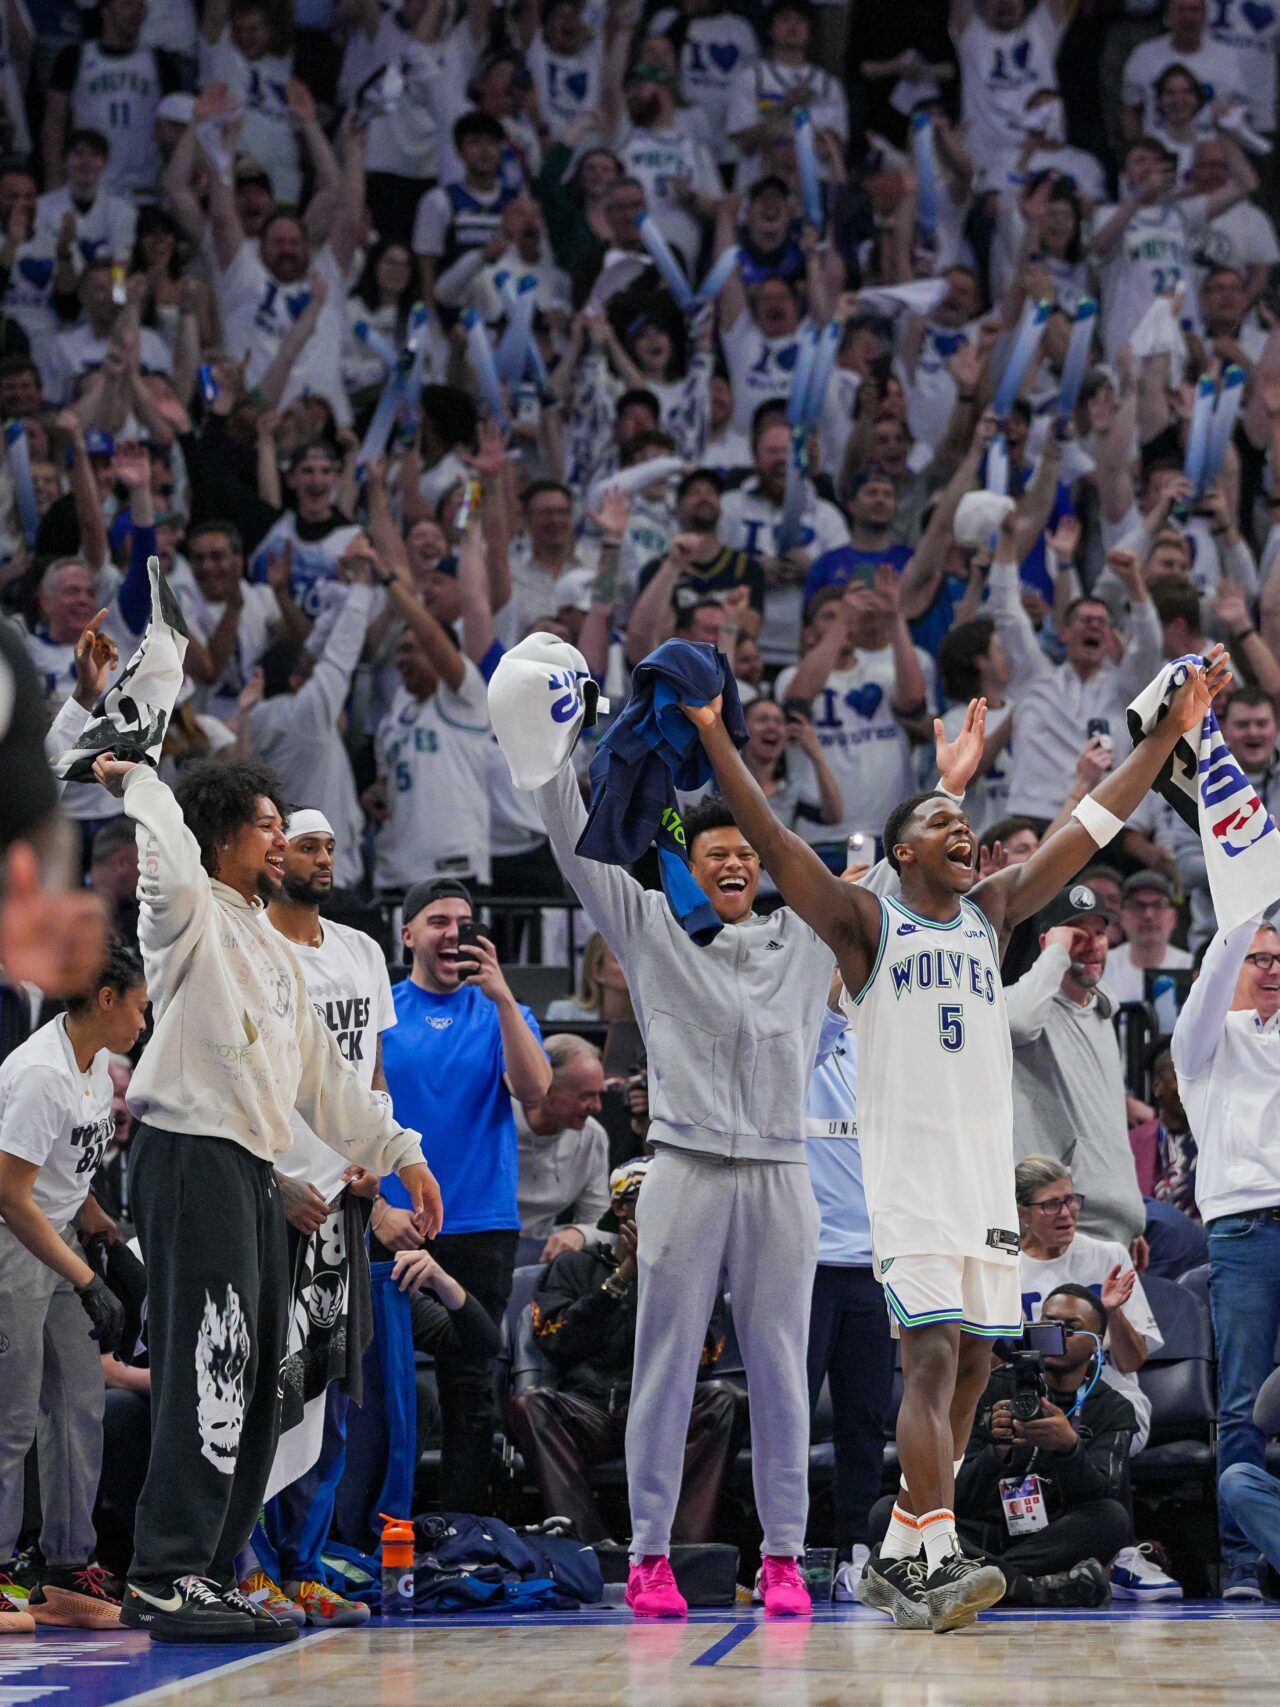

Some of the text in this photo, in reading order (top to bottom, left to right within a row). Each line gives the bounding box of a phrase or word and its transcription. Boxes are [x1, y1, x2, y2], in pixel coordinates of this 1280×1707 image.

[742, 520, 762, 555] I
[817, 687, 843, 728] I
[396, 762, 412, 792] 5
[963, 929, 987, 939] URA
[889, 948, 996, 1006] WOLVES
[937, 1003, 965, 1053] 5
